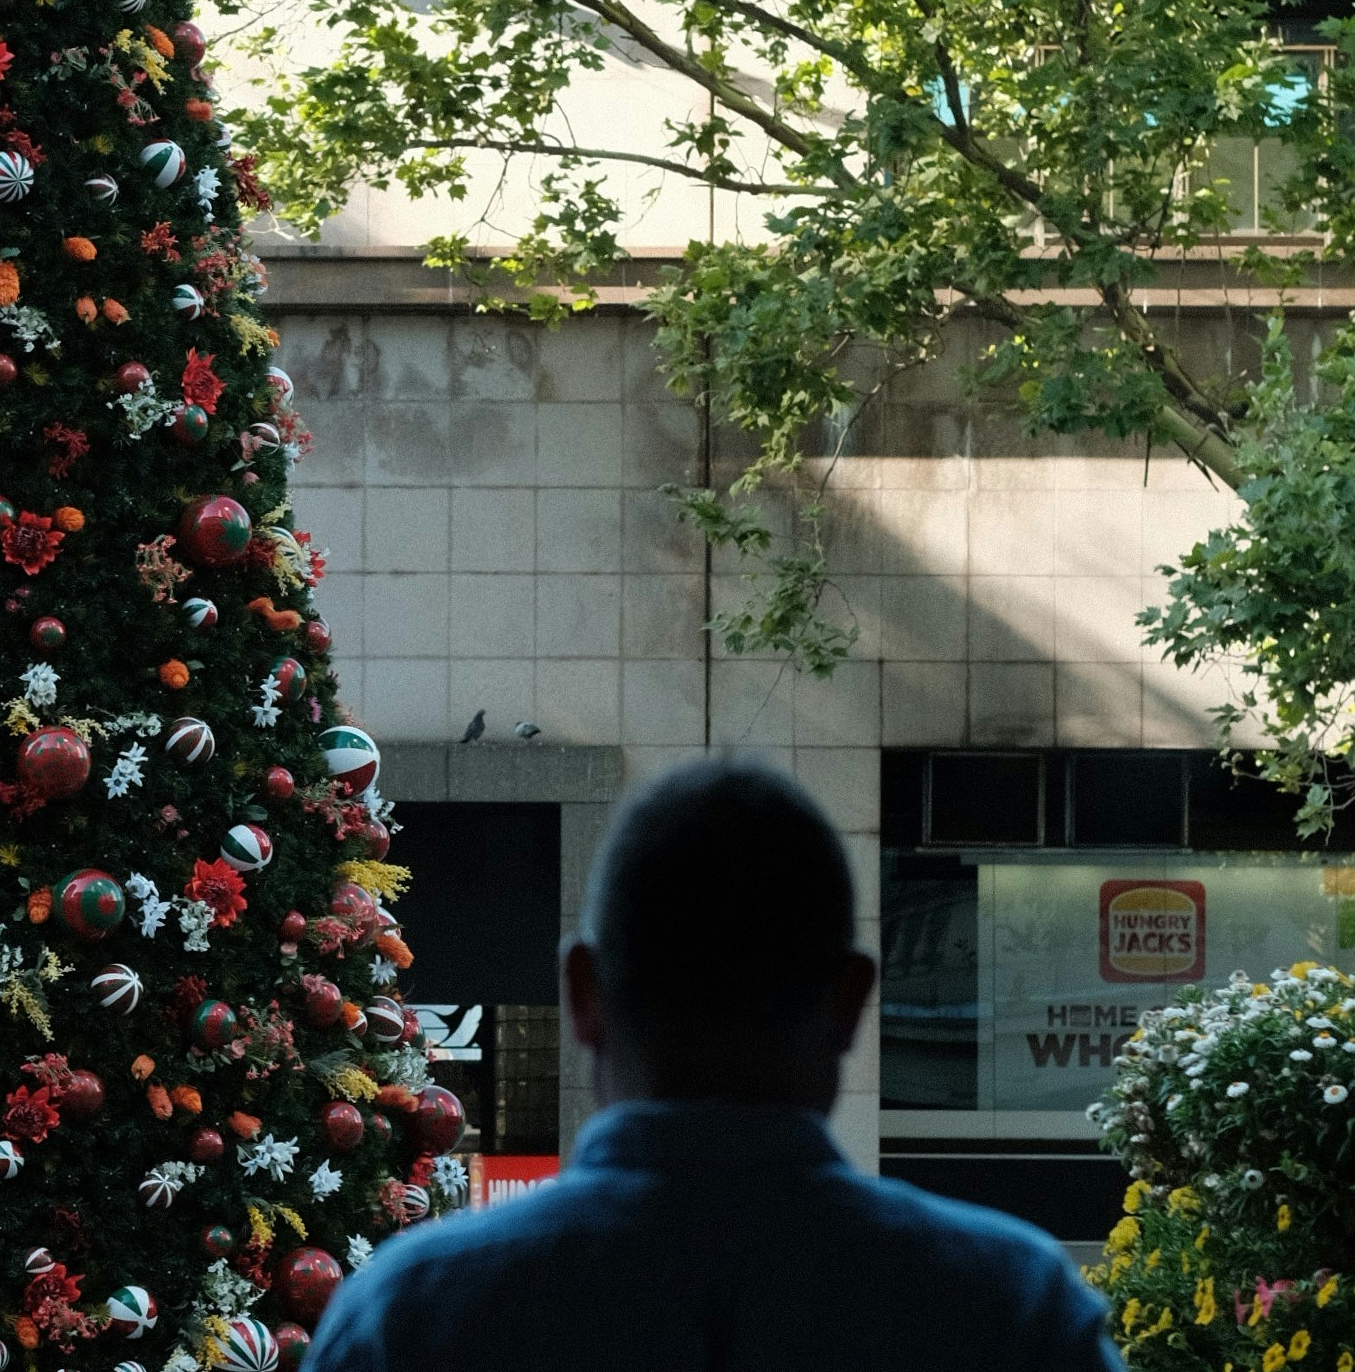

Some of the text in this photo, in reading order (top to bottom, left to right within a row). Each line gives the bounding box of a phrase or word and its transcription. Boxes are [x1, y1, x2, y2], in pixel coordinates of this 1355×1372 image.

[1114, 915, 1191, 930] HUNGRY
[1115, 933, 1192, 954] JACK'S
[1047, 1005, 1137, 1027] HOME
